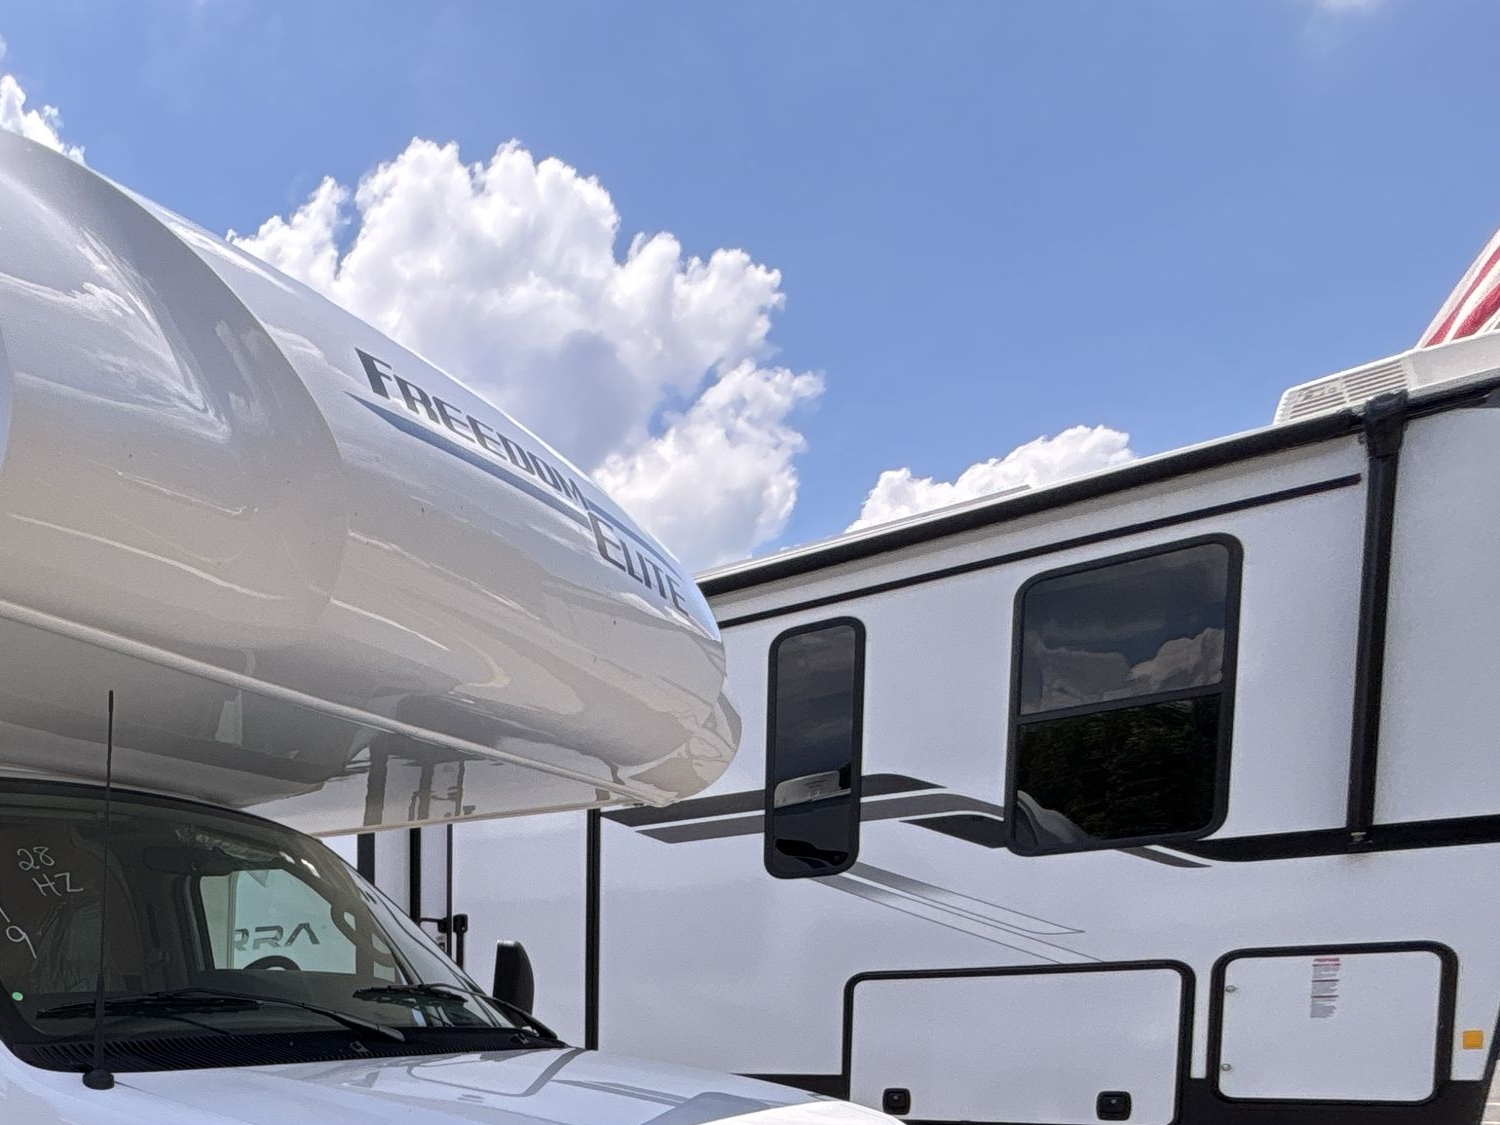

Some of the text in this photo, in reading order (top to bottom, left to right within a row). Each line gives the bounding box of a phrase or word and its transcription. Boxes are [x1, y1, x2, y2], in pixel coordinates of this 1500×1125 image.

[355, 347, 691, 618] FREEDOM ELITE
[17, 846, 56, 871] 28
